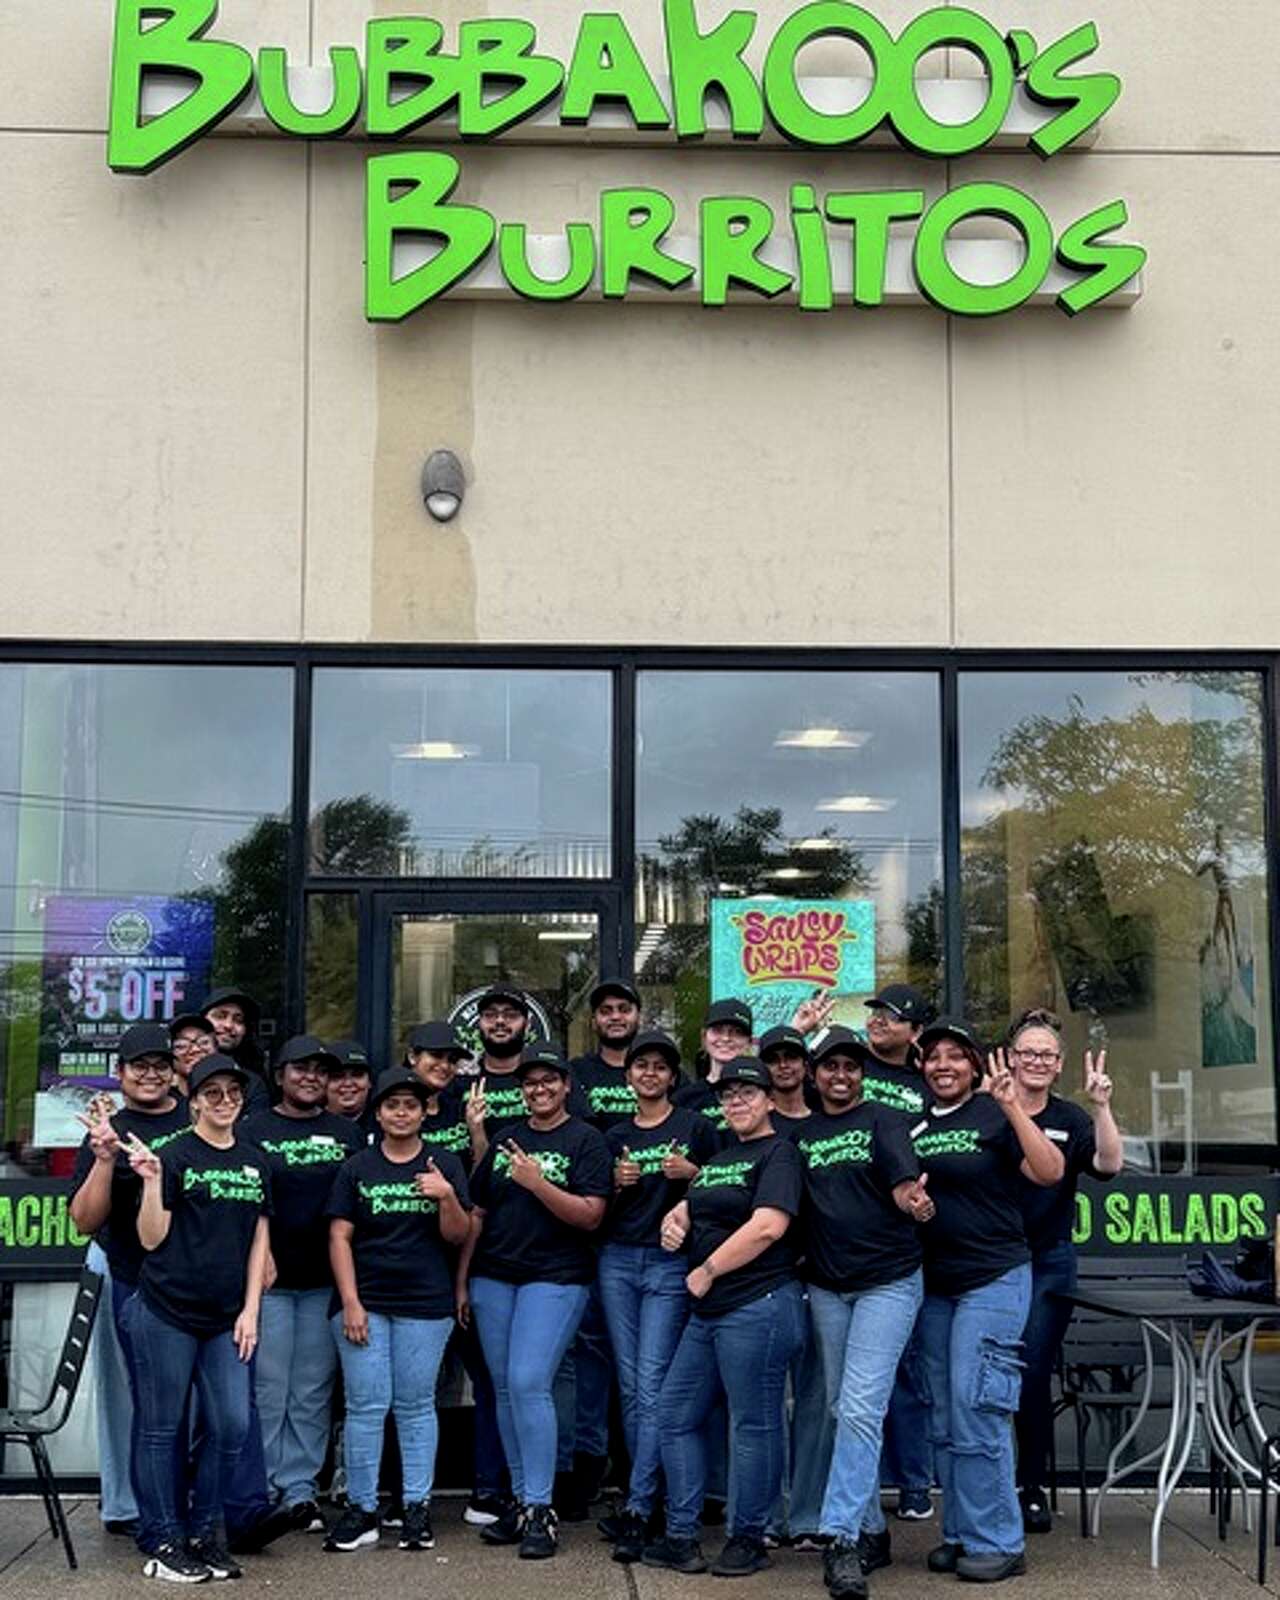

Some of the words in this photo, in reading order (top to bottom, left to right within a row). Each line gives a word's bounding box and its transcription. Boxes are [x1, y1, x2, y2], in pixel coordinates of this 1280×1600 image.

[107, 0, 1121, 174] BUBBAKOO'S
[743, 910, 845, 944] SAUCY
[743, 943, 841, 976] WRAPS
[68, 967, 107, 1020] $5
[121, 969, 186, 1020] OFF
[1104, 1192, 1265, 1244] SALADS
